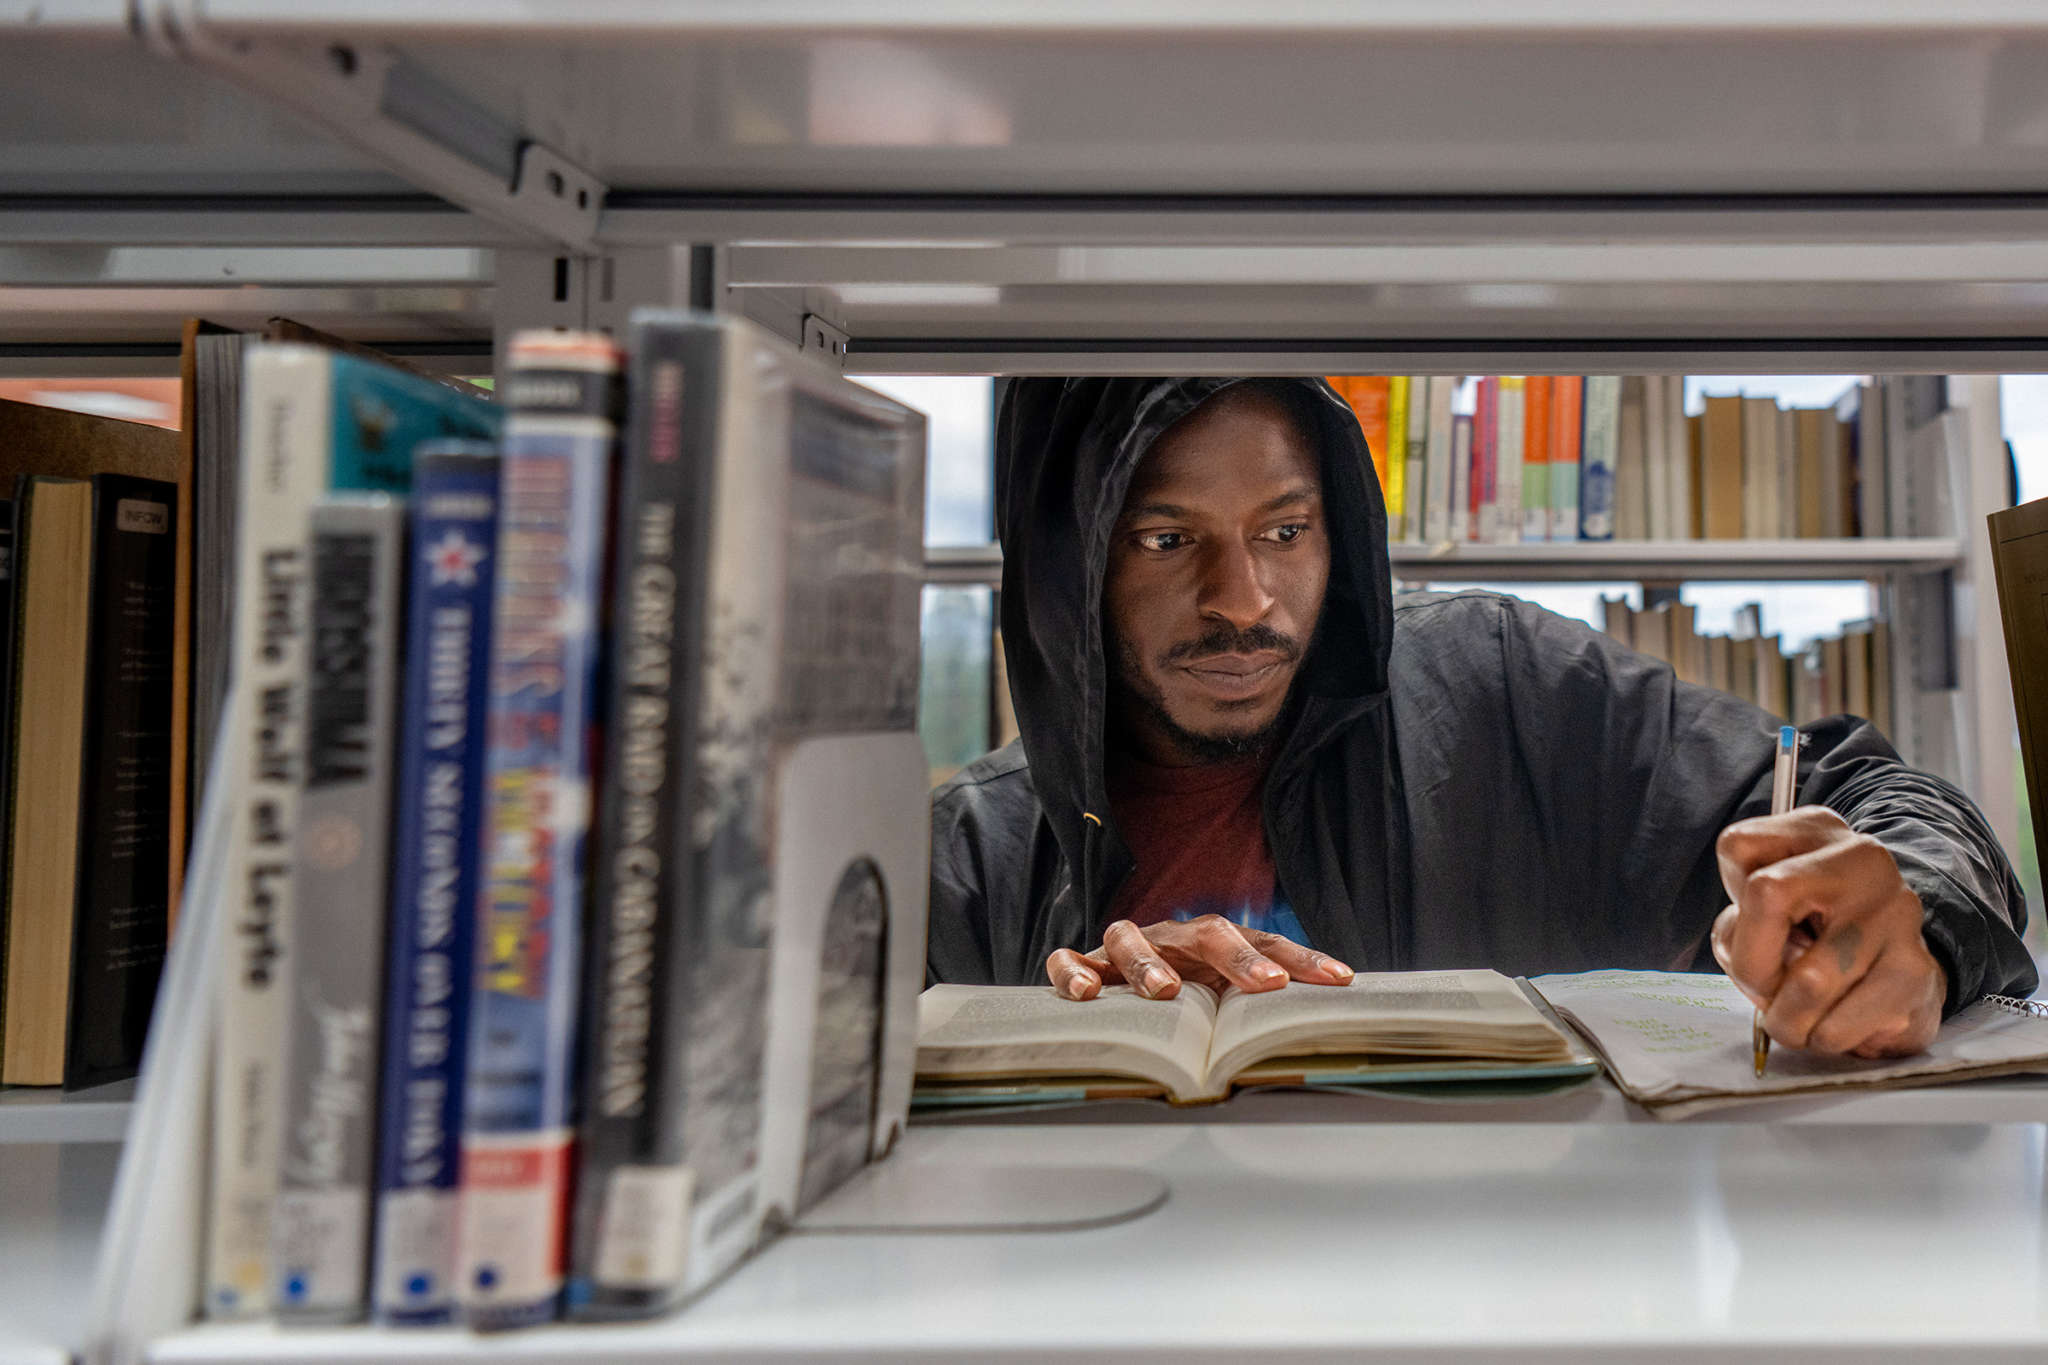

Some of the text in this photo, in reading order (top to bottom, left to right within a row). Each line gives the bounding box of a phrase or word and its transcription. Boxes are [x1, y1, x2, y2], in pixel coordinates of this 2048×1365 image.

[260, 549, 301, 665] Little
[628, 563, 677, 689] GREAT
[254, 686, 299, 783] Wolf
[622, 694, 671, 795] RAID
[238, 865, 292, 988] Leyte
